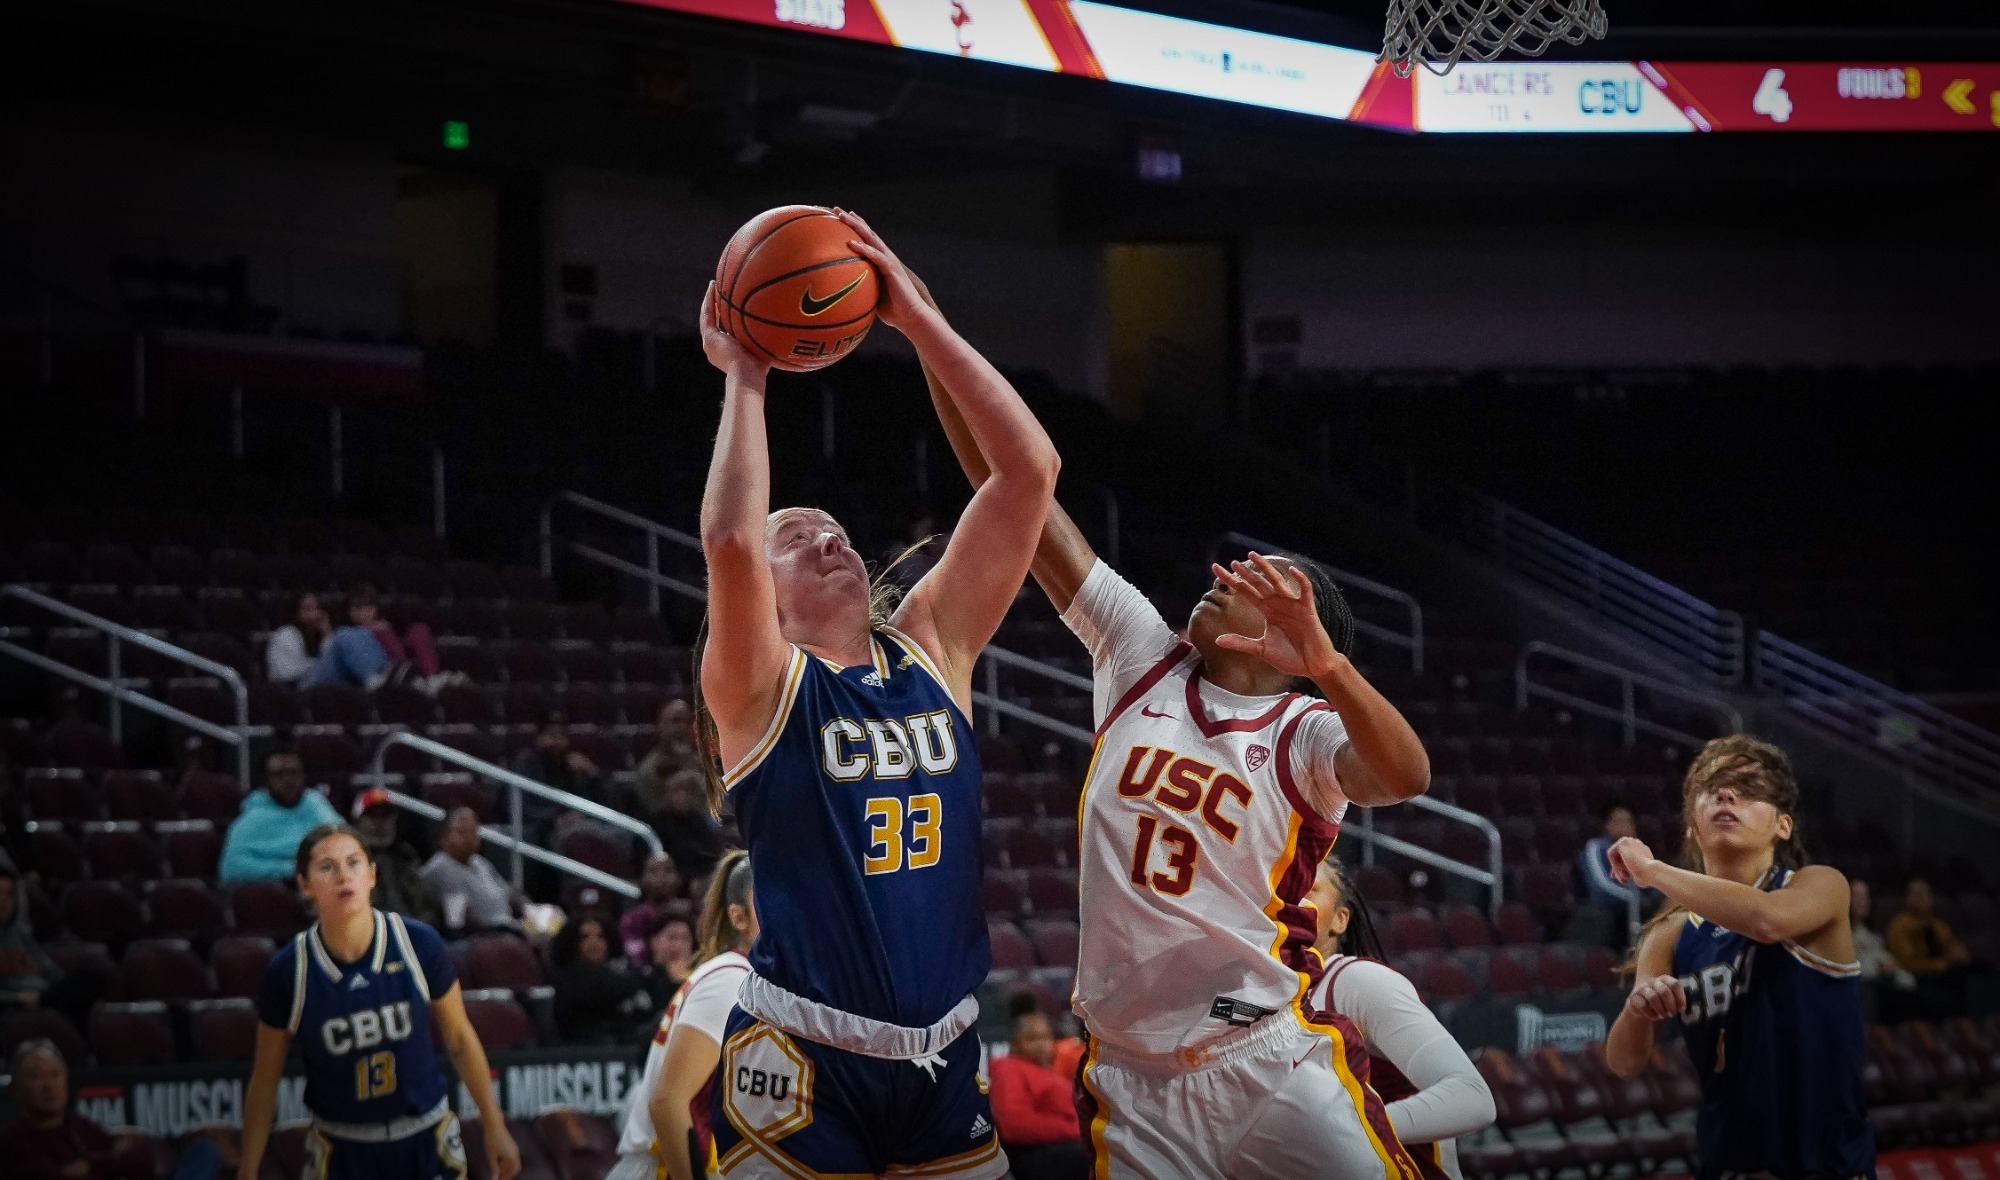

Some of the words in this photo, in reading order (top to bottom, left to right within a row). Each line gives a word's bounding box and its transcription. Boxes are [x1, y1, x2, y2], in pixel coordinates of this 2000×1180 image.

[1579, 79, 1642, 114] CBU
[1753, 68, 1793, 123] 4
[820, 708, 958, 783] CBU
[1117, 745, 1254, 846] USC
[862, 792, 943, 876] 33
[1130, 813, 1199, 899] 13
[321, 1000, 414, 1056] CBU
[354, 1050, 398, 1102] 13
[506, 1060, 628, 1120] MUSCLE
[736, 1066, 791, 1103] CBU
[133, 1078, 244, 1139] MUSCL
